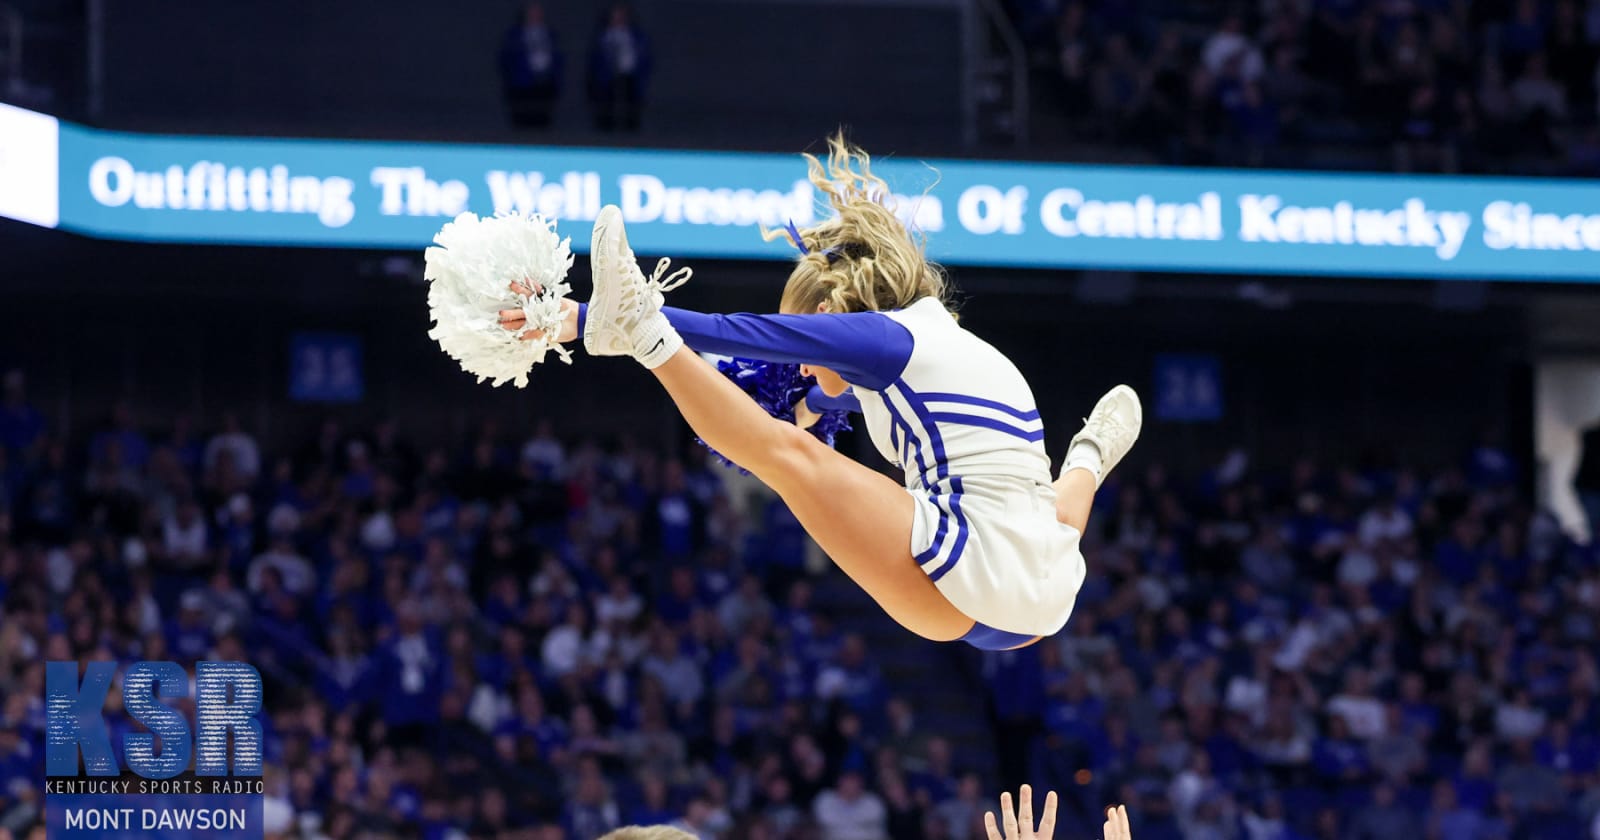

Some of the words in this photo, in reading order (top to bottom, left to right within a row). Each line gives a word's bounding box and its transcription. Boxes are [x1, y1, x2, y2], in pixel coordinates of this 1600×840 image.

[89, 156, 355, 228] Outfitting
[370, 166, 469, 218] The
[486, 169, 601, 222] Well
[619, 173, 815, 226] Dressed
[957, 184, 1029, 235] Of
[1040, 187, 1223, 241] Central
[1238, 193, 1472, 261] Kentucky
